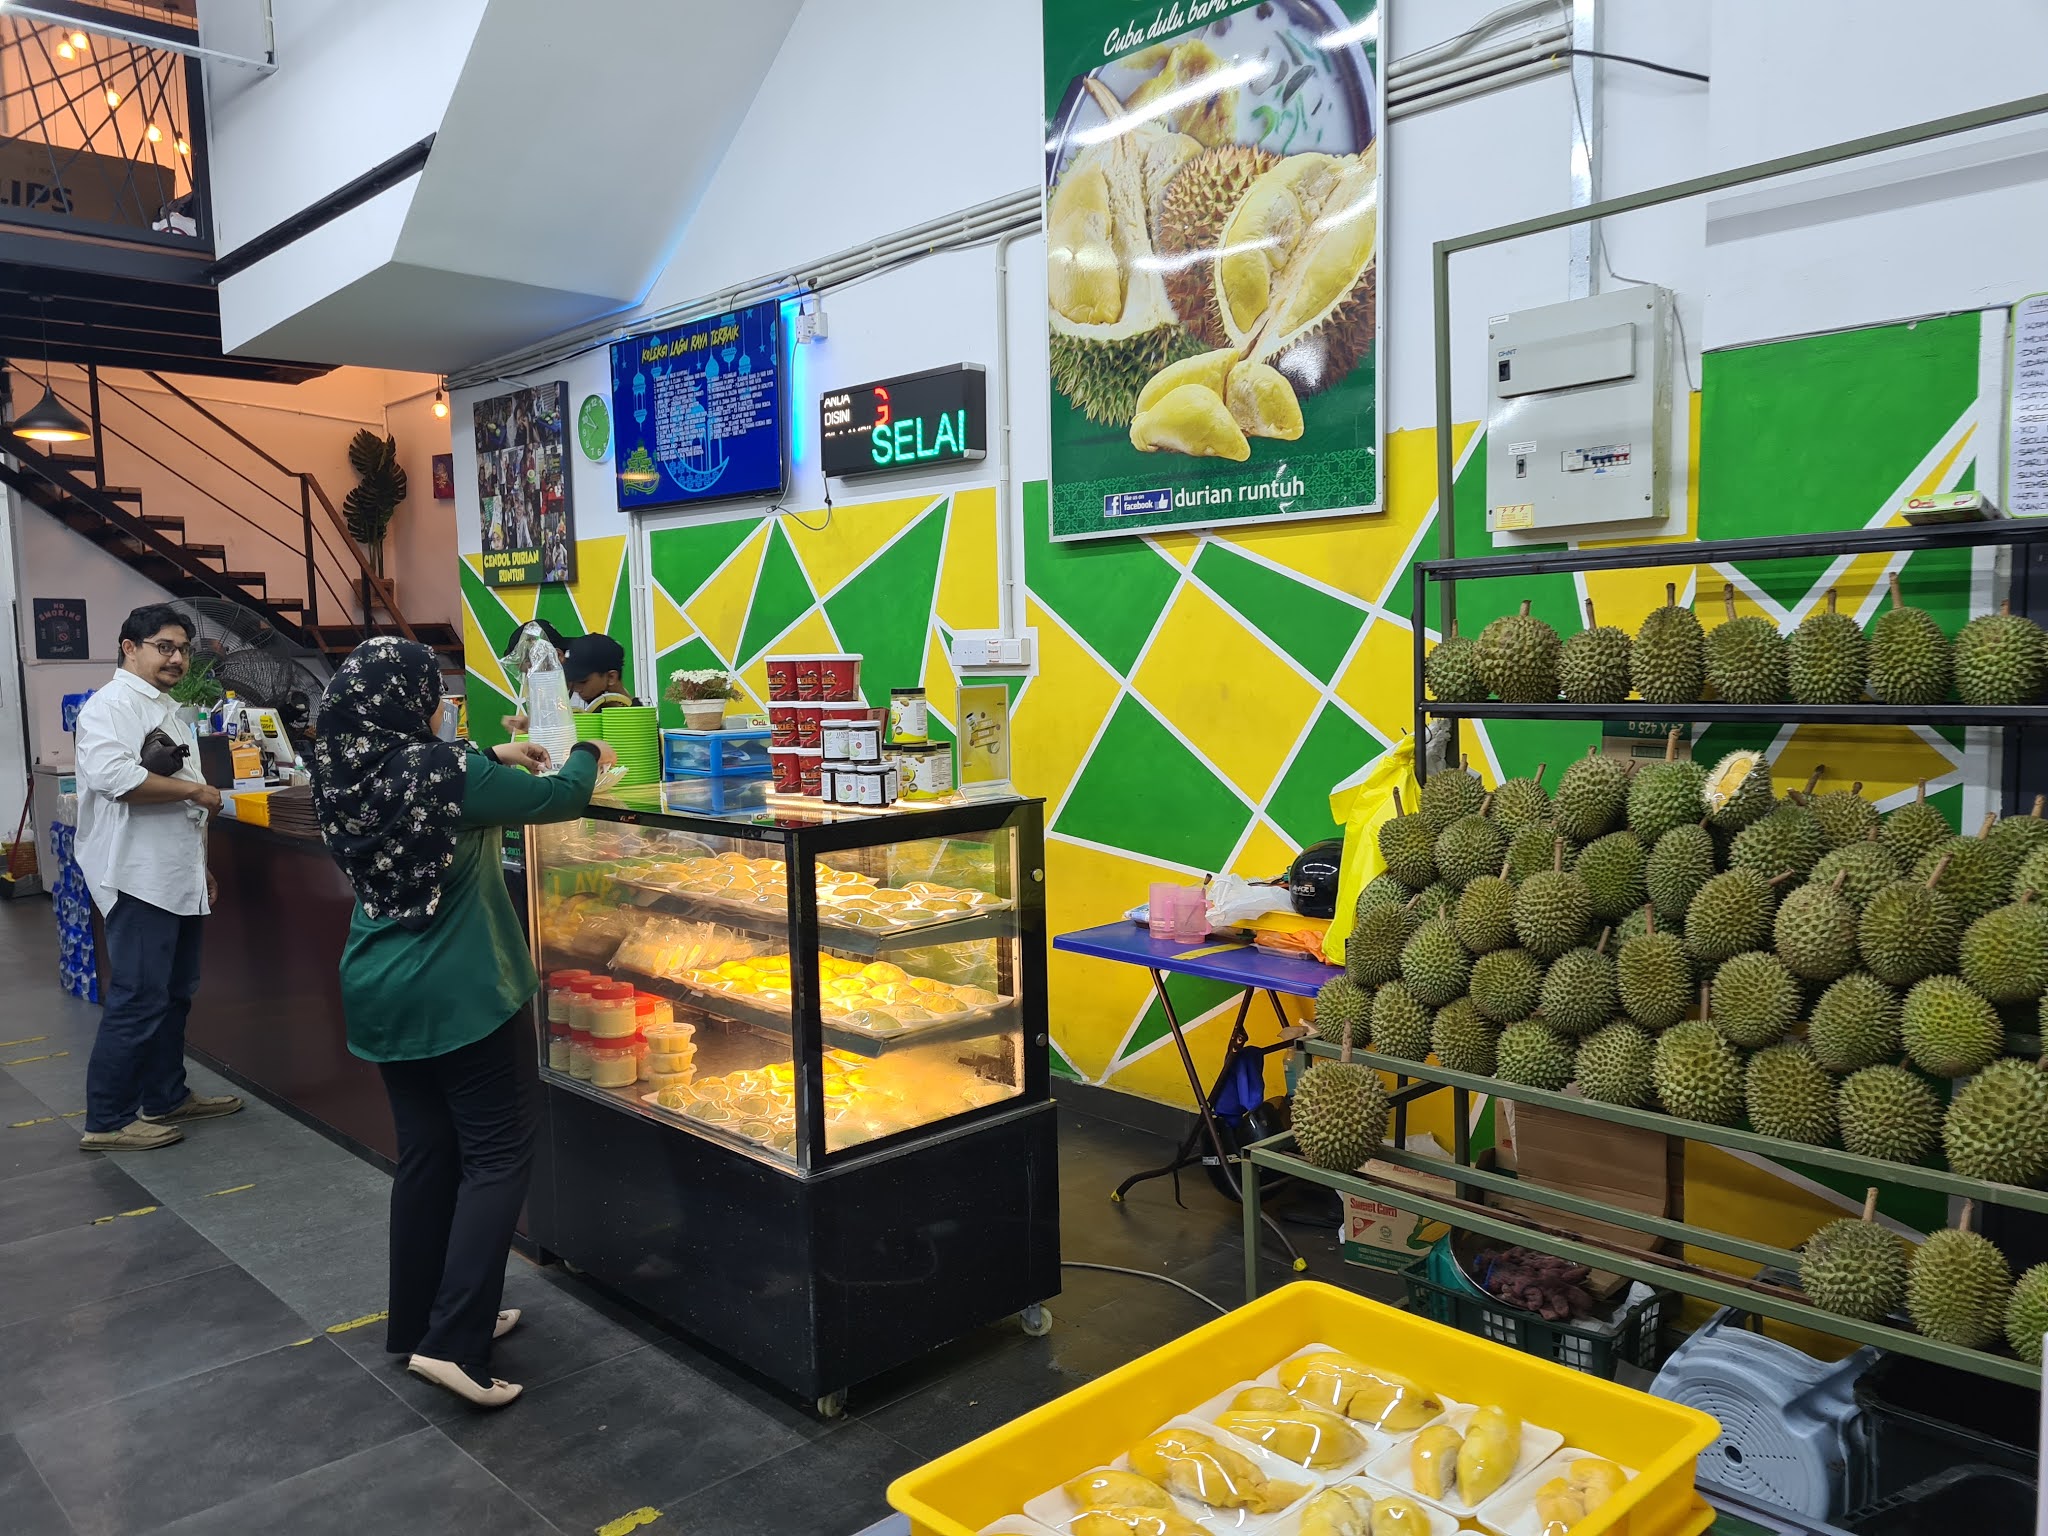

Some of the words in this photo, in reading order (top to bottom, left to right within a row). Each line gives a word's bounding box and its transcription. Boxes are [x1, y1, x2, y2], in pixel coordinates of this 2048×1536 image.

[1103, 27, 1144, 57] Cuba
[1146, 7, 1185, 38] dulu
[642, 344, 668, 364] KOLEKSI
[670, 338, 689, 356] LAGU
[691, 332, 708, 351] RAYA
[711, 324, 740, 346] TERBAIK
[825, 408, 850, 426] DISINI
[1175, 486, 1231, 507] durian
[1239, 476, 1304, 501] runtuh
[1124, 500, 1153, 510] facebook
[484, 553, 511, 568] CENDOL
[512, 550, 539, 566] DURIAN
[498, 568, 525, 582] RUNTUH
[39, 610, 81, 621] SMOKING
[1350, 1197, 1376, 1214] Sweet
[1377, 1203, 1398, 1218] Corn
